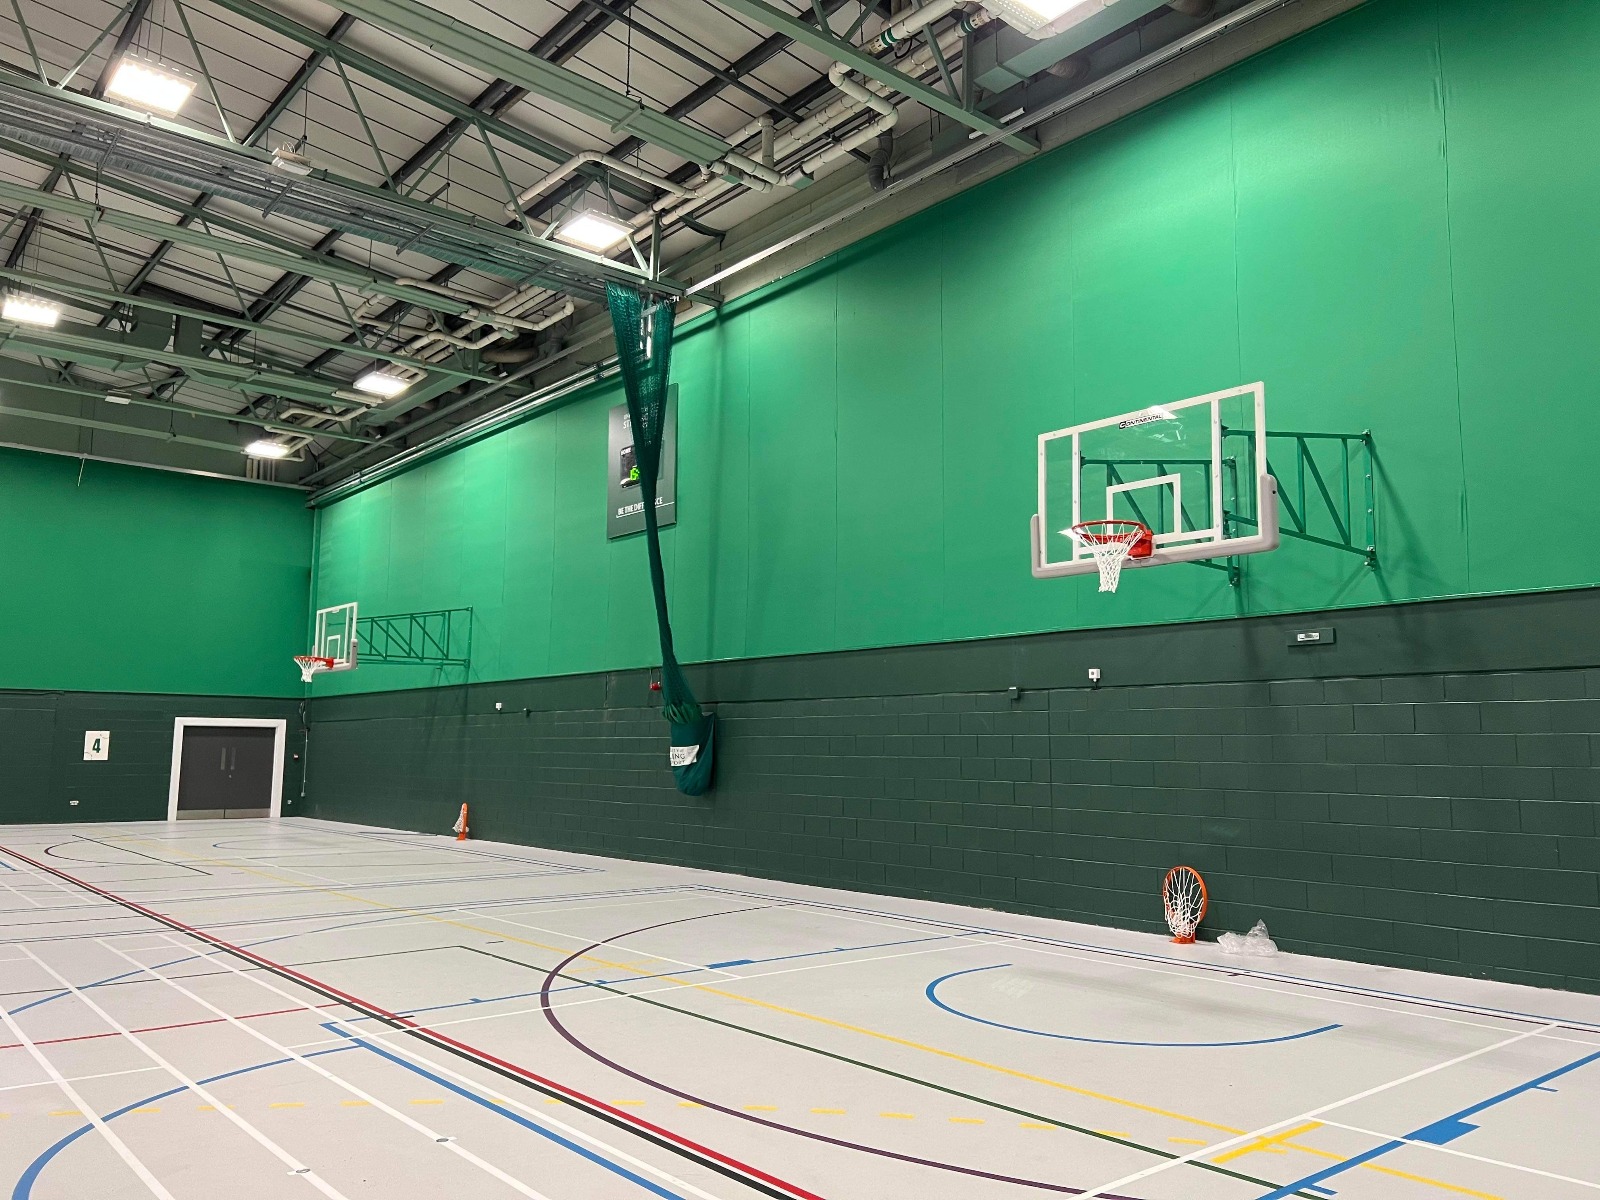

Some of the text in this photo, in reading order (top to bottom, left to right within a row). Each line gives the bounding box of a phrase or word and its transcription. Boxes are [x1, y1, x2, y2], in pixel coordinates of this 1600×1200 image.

[1119, 414, 1162, 429] CONTINENTAL
[618, 507, 624, 515] BE
[625, 505, 633, 514] THE
[92, 738, 101, 753] 4
